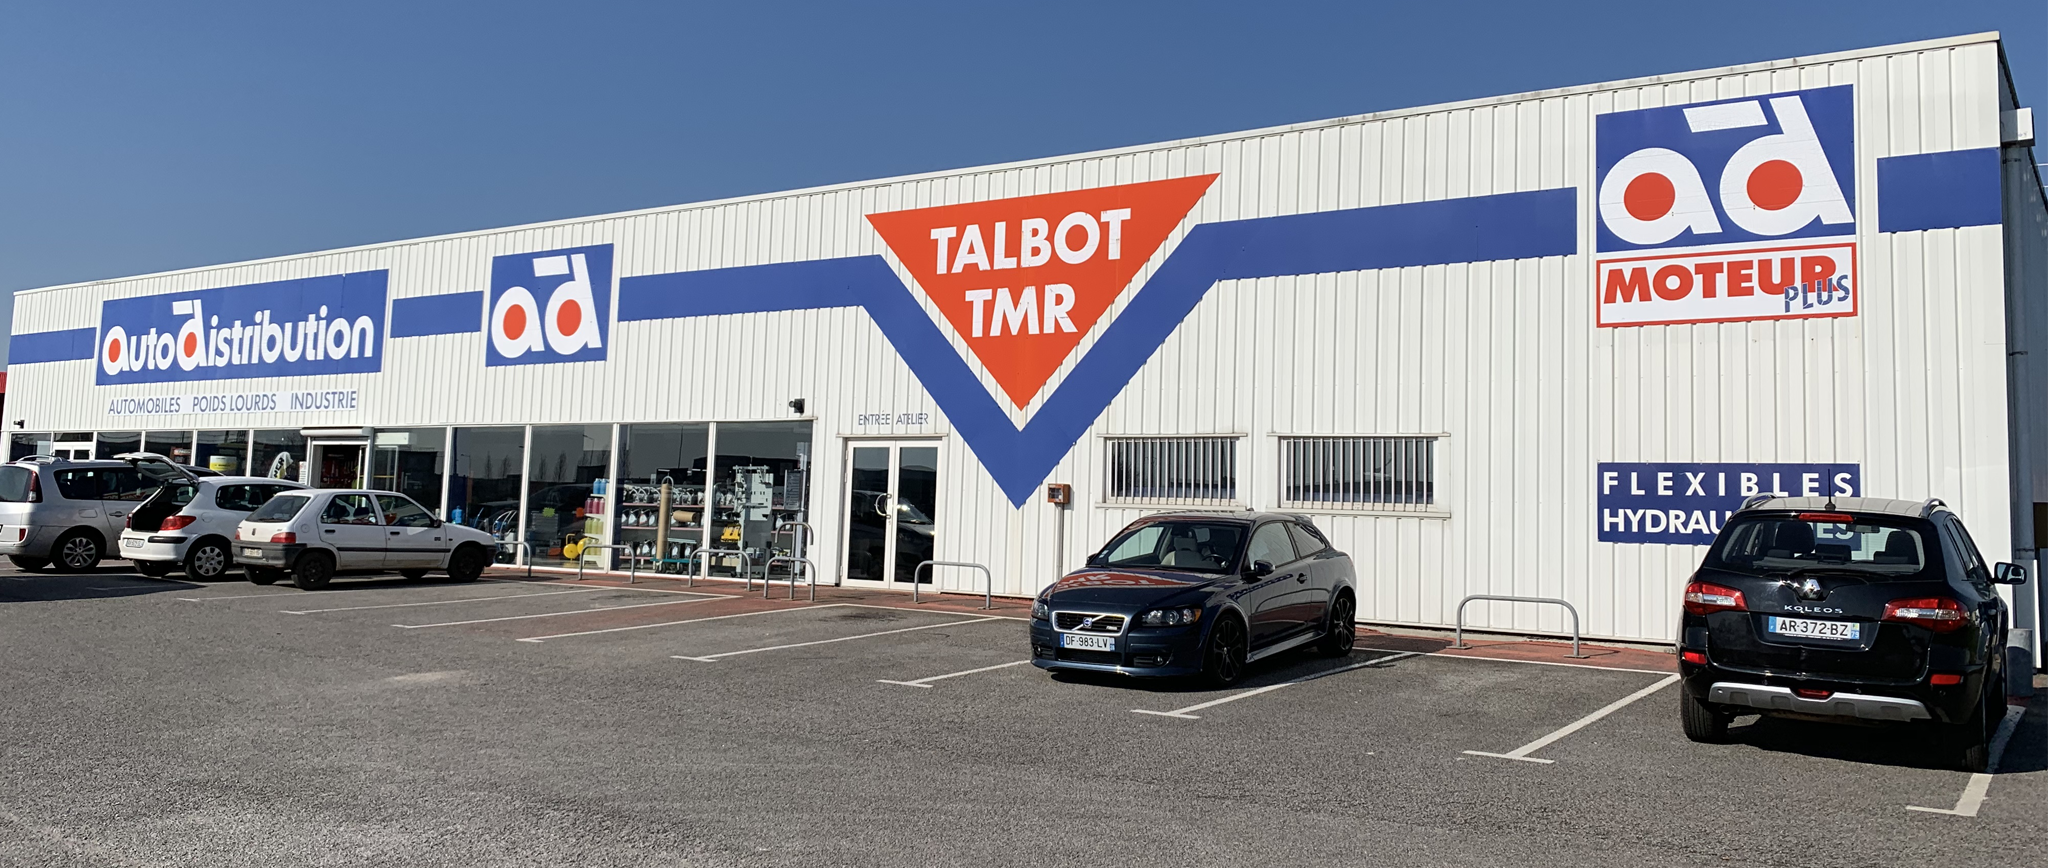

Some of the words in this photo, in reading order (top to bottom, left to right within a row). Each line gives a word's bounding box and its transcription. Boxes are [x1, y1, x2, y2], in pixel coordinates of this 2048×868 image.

[930, 208, 1131, 275] TALBOT
[1603, 255, 1840, 305] MOTEUR
[1784, 274, 1850, 313] PLUS
[965, 283, 1078, 338] TMR
[108, 397, 181, 415] AUTOMOBILES
[192, 395, 227, 413] POIDS
[229, 393, 277, 412] LOURDS
[290, 390, 357, 410] INDUSTRIE
[858, 410, 890, 426] ENTRÉE
[896, 413, 929, 425] ATELIER
[1603, 471, 1853, 498] FLEXIBLES
[1784, 605, 1843, 614] KOLEOS
